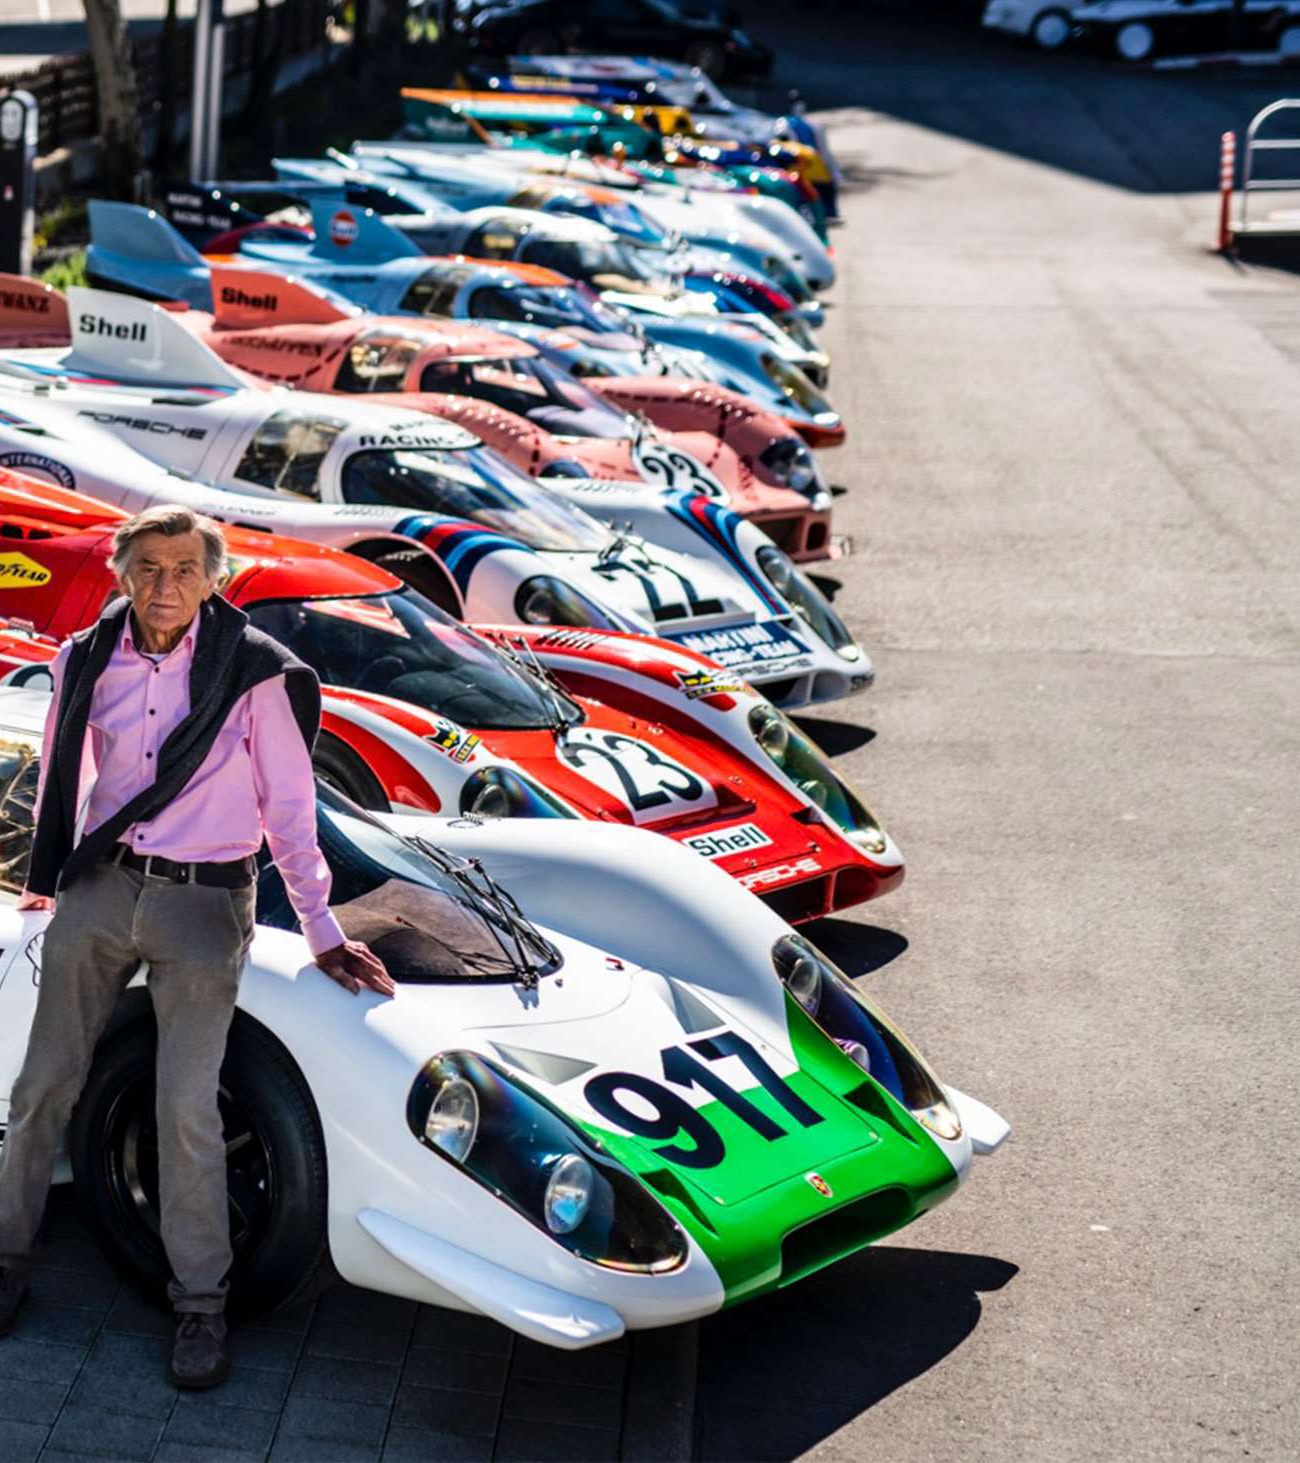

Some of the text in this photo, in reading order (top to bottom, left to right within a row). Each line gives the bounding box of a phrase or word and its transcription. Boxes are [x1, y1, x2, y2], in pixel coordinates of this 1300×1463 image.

[221, 287, 277, 311] Shell
[79, 314, 147, 342] Shell
[642, 453, 723, 498] 23
[563, 734, 703, 811] 23
[688, 824, 769, 858] Shell
[583, 1030, 826, 1170] 917
